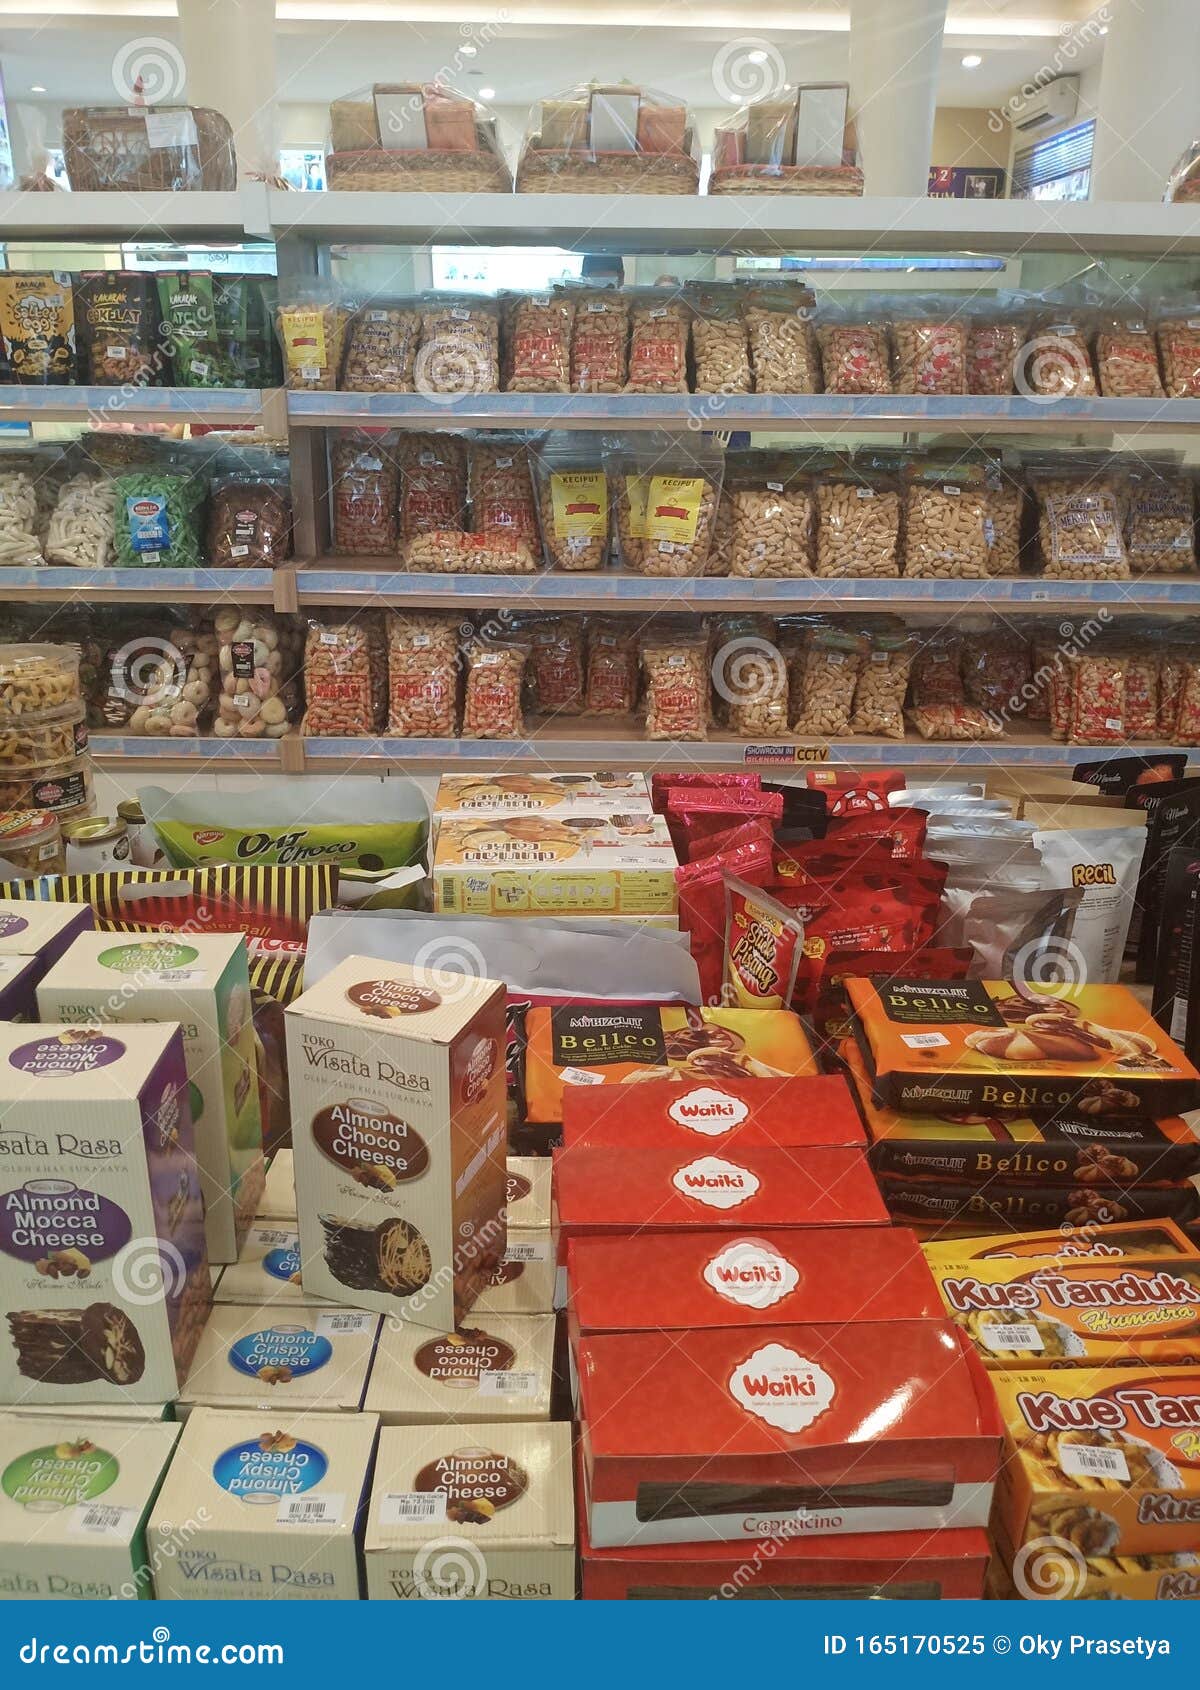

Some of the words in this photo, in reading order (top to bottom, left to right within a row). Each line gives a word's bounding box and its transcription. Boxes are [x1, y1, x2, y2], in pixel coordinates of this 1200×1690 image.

[939, 169, 949, 182] 2
[562, 475, 599, 484] KECIPUT
[661, 478, 697, 488] KECIPUT
[746, 746, 784, 755] SHOWROOM
[797, 748, 829, 761] CCTV
[239, 923, 271, 937] Ball
[731, 937, 779, 994] Pisang
[372, 980, 435, 998] Almond
[372, 987, 421, 1003] Choco
[359, 993, 420, 1011] Cheese
[888, 994, 989, 1014] Bellco
[58, 1004, 97, 1017] TOKO
[37, 1044, 108, 1053] Cheese
[302, 1033, 336, 1049] TOKO
[559, 1032, 658, 1050] Bellco
[35, 1052, 98, 1062] Mocca
[23, 1060, 98, 1071] Almond
[302, 1045, 371, 1079] Wisata
[377, 1060, 433, 1094] Rasa
[981, 1085, 1072, 1104] Bellco
[679, 1102, 735, 1117] Waiki
[331, 1105, 409, 1138] Almond
[338, 1122, 401, 1151] Choco
[55, 1133, 124, 1160] Rasa
[332, 1138, 409, 1171] Cheese
[976, 1152, 1068, 1172] Bellco
[684, 1173, 745, 1189] Waiki
[5, 1193, 101, 1212] Almond
[968, 1195, 1059, 1215] Bellco
[15, 1212, 98, 1230] Mocca
[11, 1229, 105, 1247] Cheese
[716, 1264, 782, 1283] Waiki
[944, 1279, 1039, 1309] Kue
[1035, 1273, 1200, 1306] Tanduk
[1080, 1306, 1196, 1332] Humaira
[251, 1332, 318, 1345] Almond
[253, 1343, 309, 1358] Crispy
[434, 1345, 499, 1357] Cheese
[244, 1354, 311, 1367] Cheese
[438, 1355, 493, 1369] Choco
[430, 1367, 480, 1379] mond
[743, 1373, 817, 1398] Waiki
[1019, 1394, 1125, 1431] Kue
[30, 1457, 102, 1474] Cheese
[239, 1451, 309, 1467] Cheese
[435, 1456, 509, 1472] Almond
[28, 1469, 91, 1487] Crispy
[239, 1463, 300, 1481] Crispy
[441, 1471, 501, 1485] Choco
[229, 1477, 304, 1493] Almond
[434, 1485, 507, 1499] Cheese
[13, 1486, 90, 1501] Almond
[176, 1550, 217, 1561] TOKO
[178, 1558, 262, 1584] Wisata
[271, 1564, 335, 1589] Rasa
[48, 1575, 113, 1598] Rasa
[486, 1578, 553, 1599] Rasa
